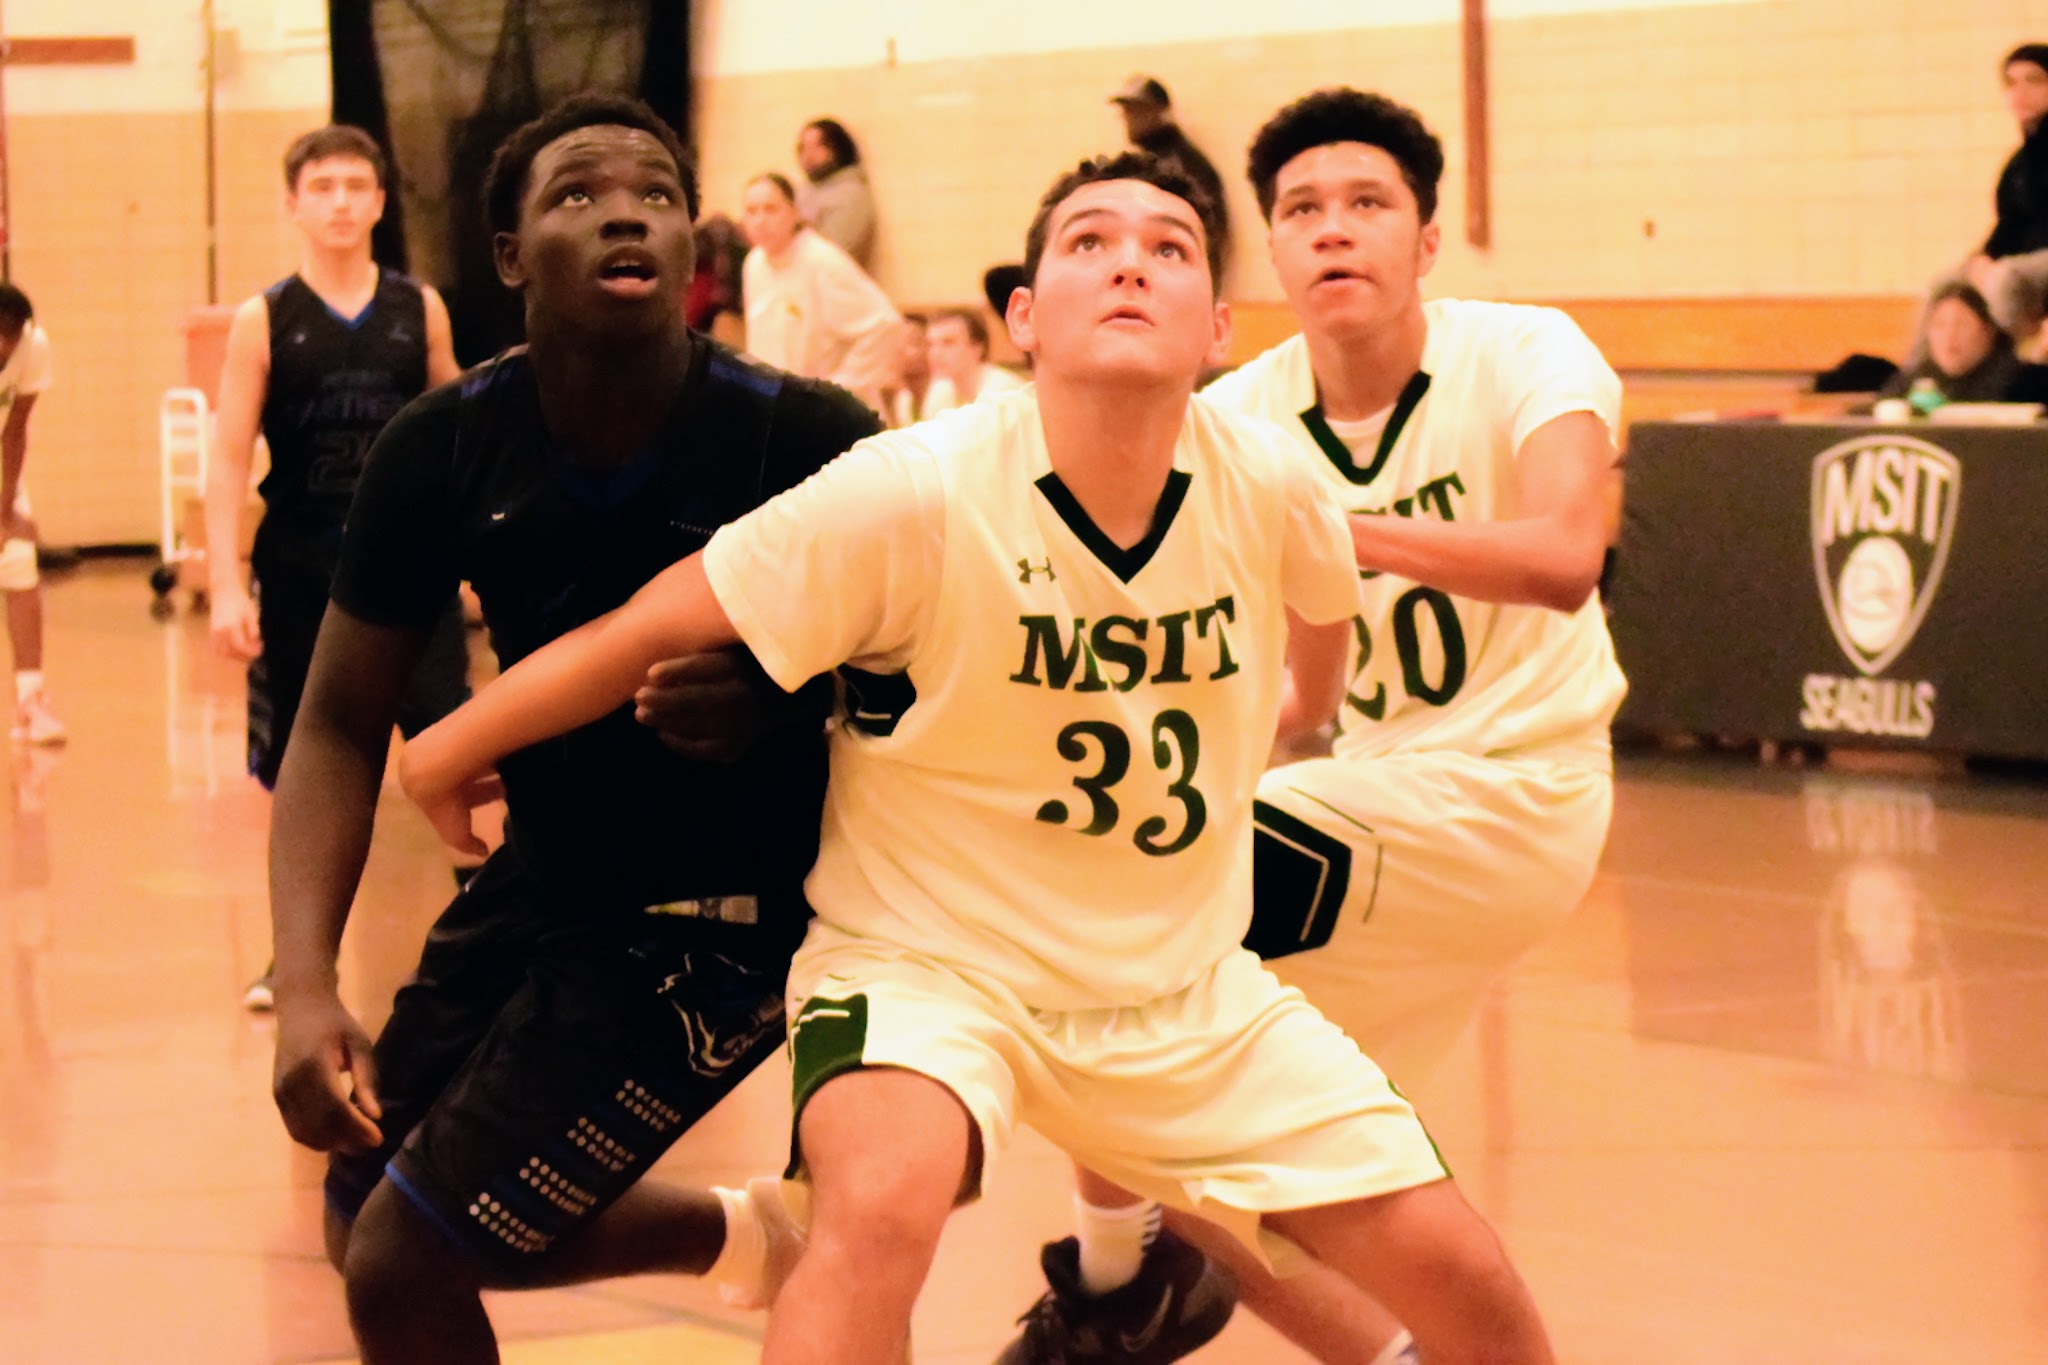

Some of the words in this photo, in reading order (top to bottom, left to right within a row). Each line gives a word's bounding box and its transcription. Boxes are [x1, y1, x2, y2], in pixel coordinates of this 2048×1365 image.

[1821, 447, 1952, 546] MSIT
[1009, 595, 1240, 693] MSIT
[1800, 673, 1937, 738] SEAGULLS
[1035, 708, 1207, 857] 33
